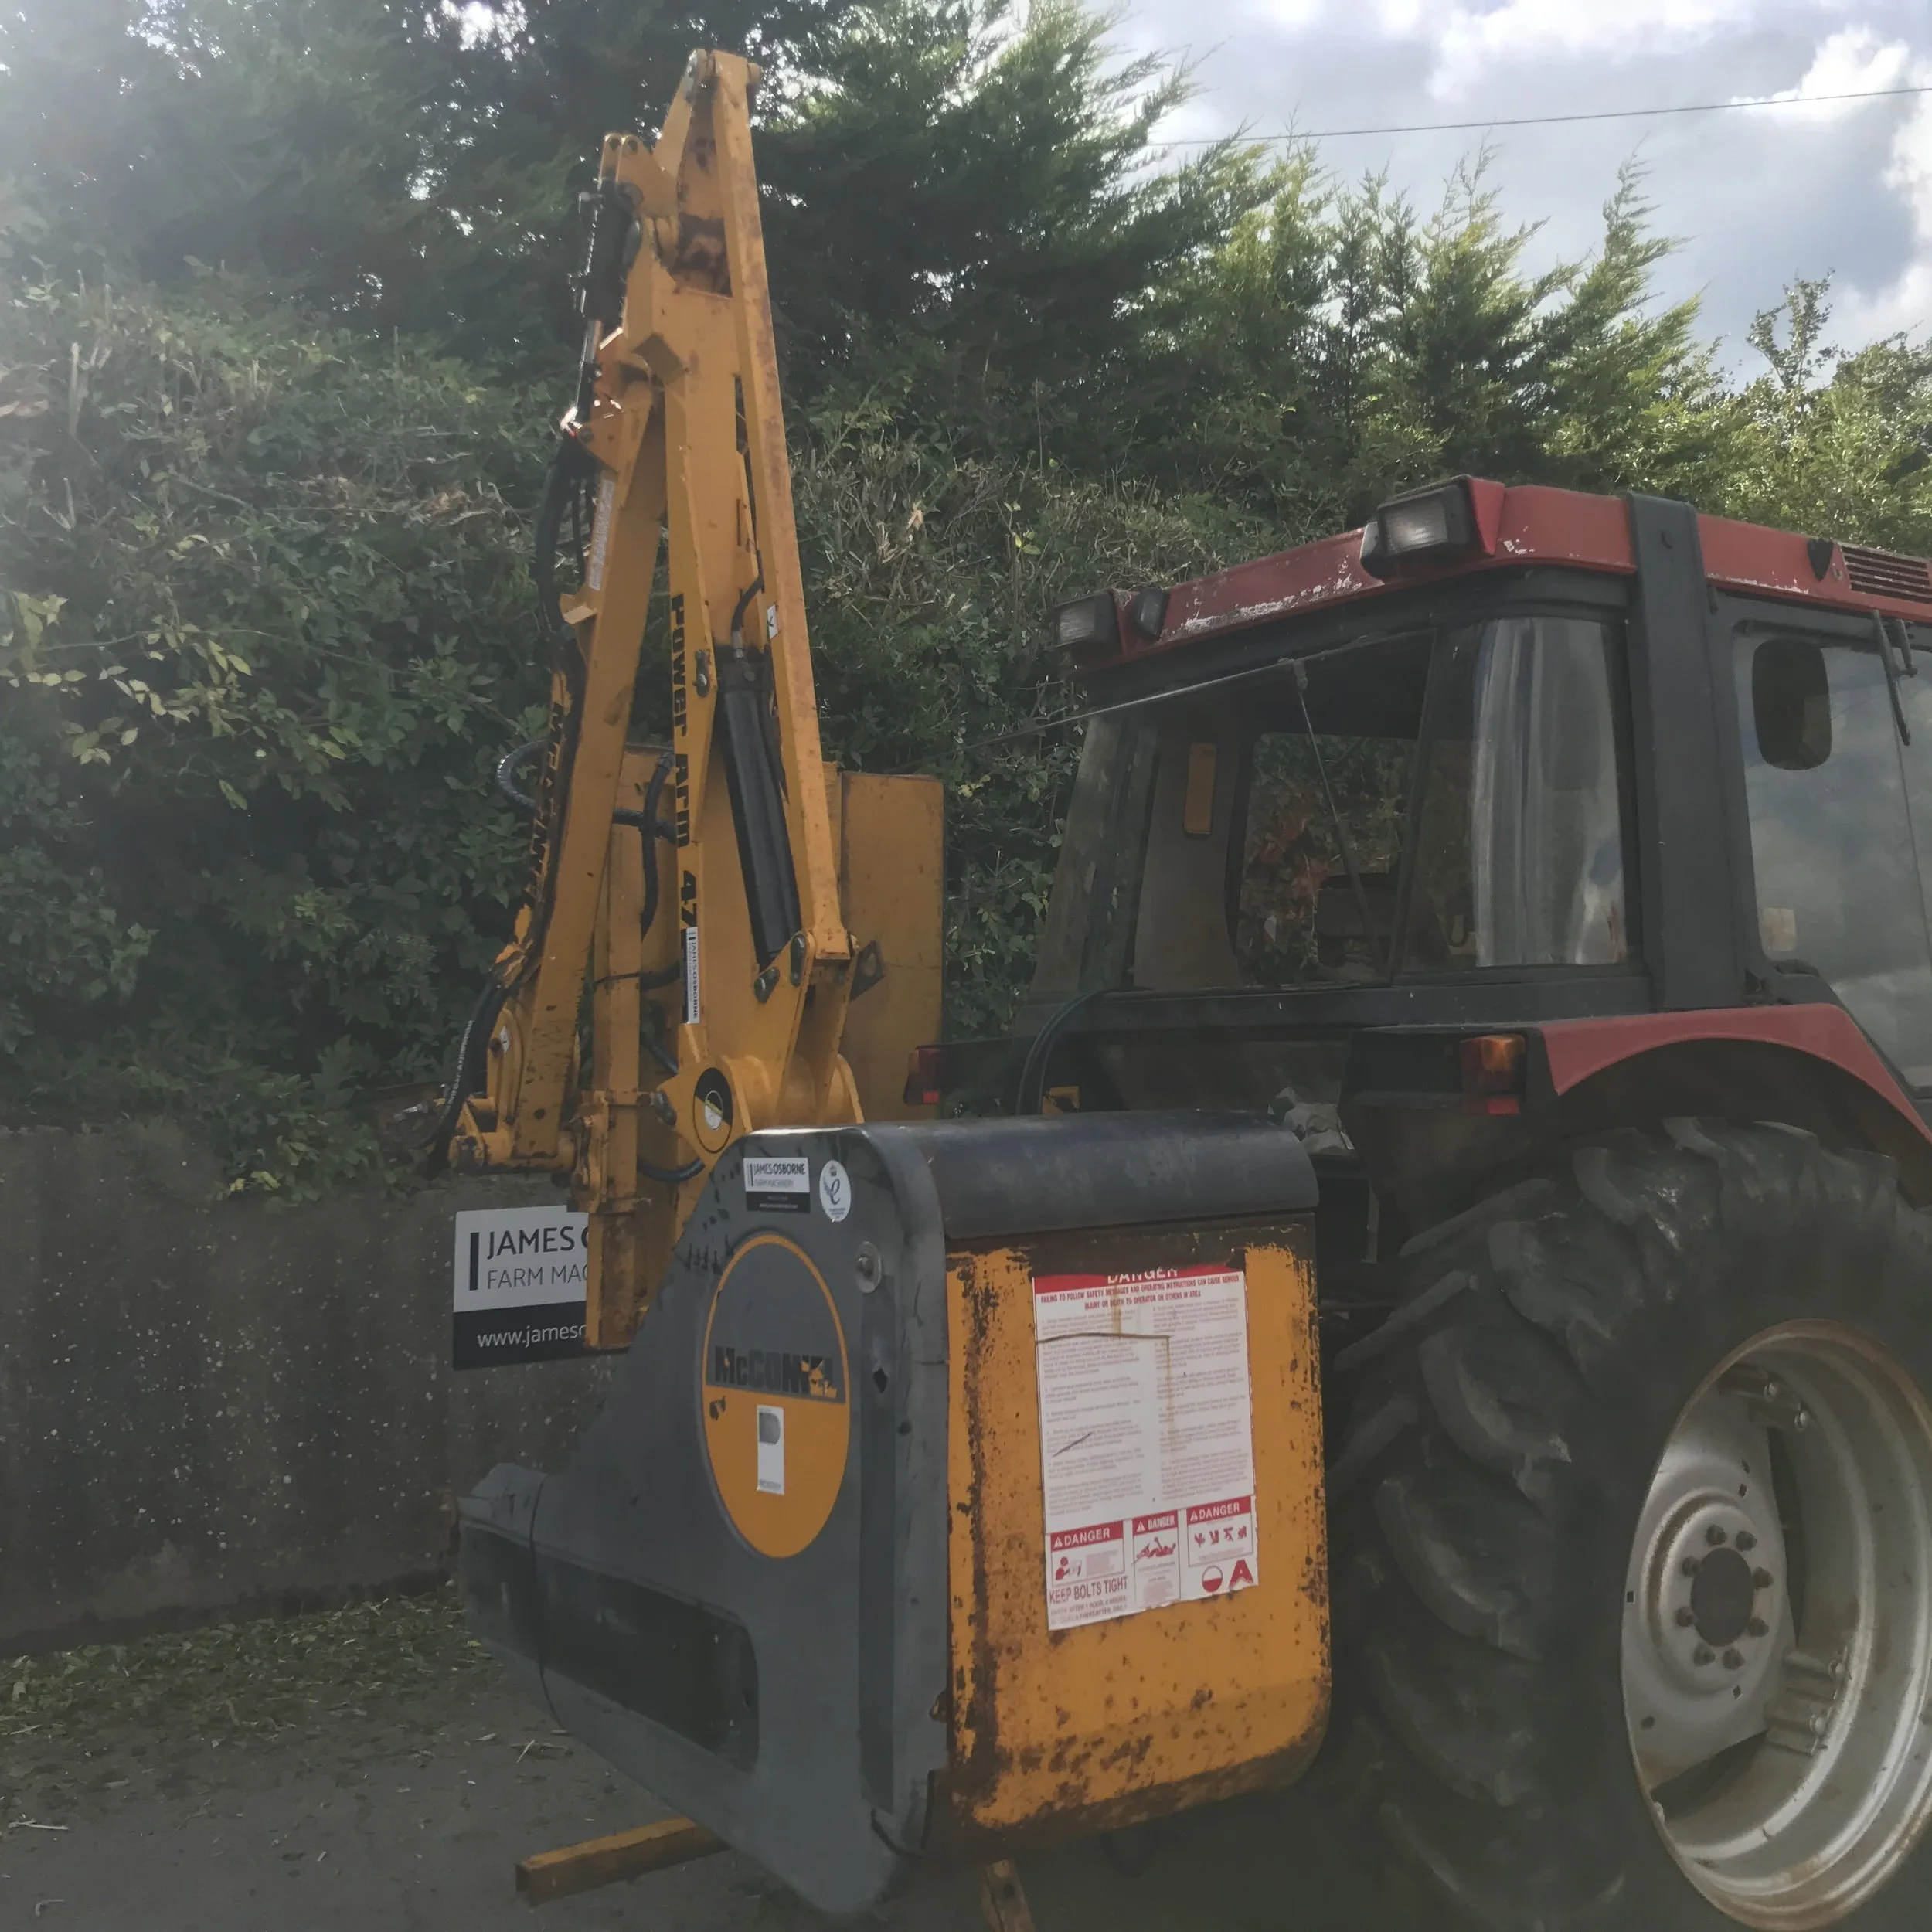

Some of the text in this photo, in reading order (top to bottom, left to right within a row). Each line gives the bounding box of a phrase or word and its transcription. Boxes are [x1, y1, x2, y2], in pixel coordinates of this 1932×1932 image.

[753, 1162, 806, 1175] JAMES OSBORNE
[487, 1226, 575, 1260] JAMES
[487, 1267, 543, 1290] FARM
[1059, 1293, 1066, 1301] TO
[1067, 1291, 1084, 1301] FOLLOW
[1086, 1289, 1104, 1299] SAFETY
[1141, 1283, 1165, 1292] OPERATING
[1166, 1280, 1196, 1290] INSTRUCTIONS
[1197, 1278, 1206, 1287] CAN
[1207, 1277, 1221, 1285] CAUSE
[1125, 1297, 1132, 1305] TO
[1165, 1291, 1182, 1300] OTHERS
[1189, 1289, 1202, 1298] AREA
[1199, 1502, 1240, 1520] DANGER
[1147, 1515, 1175, 1530] DANGER
[1063, 1527, 1111, 1546] DANGER
[1049, 1587, 1072, 1605] KEEP
[1073, 1581, 1102, 1600] BOLTS
[1104, 1576, 1128, 1594] TIGHT
